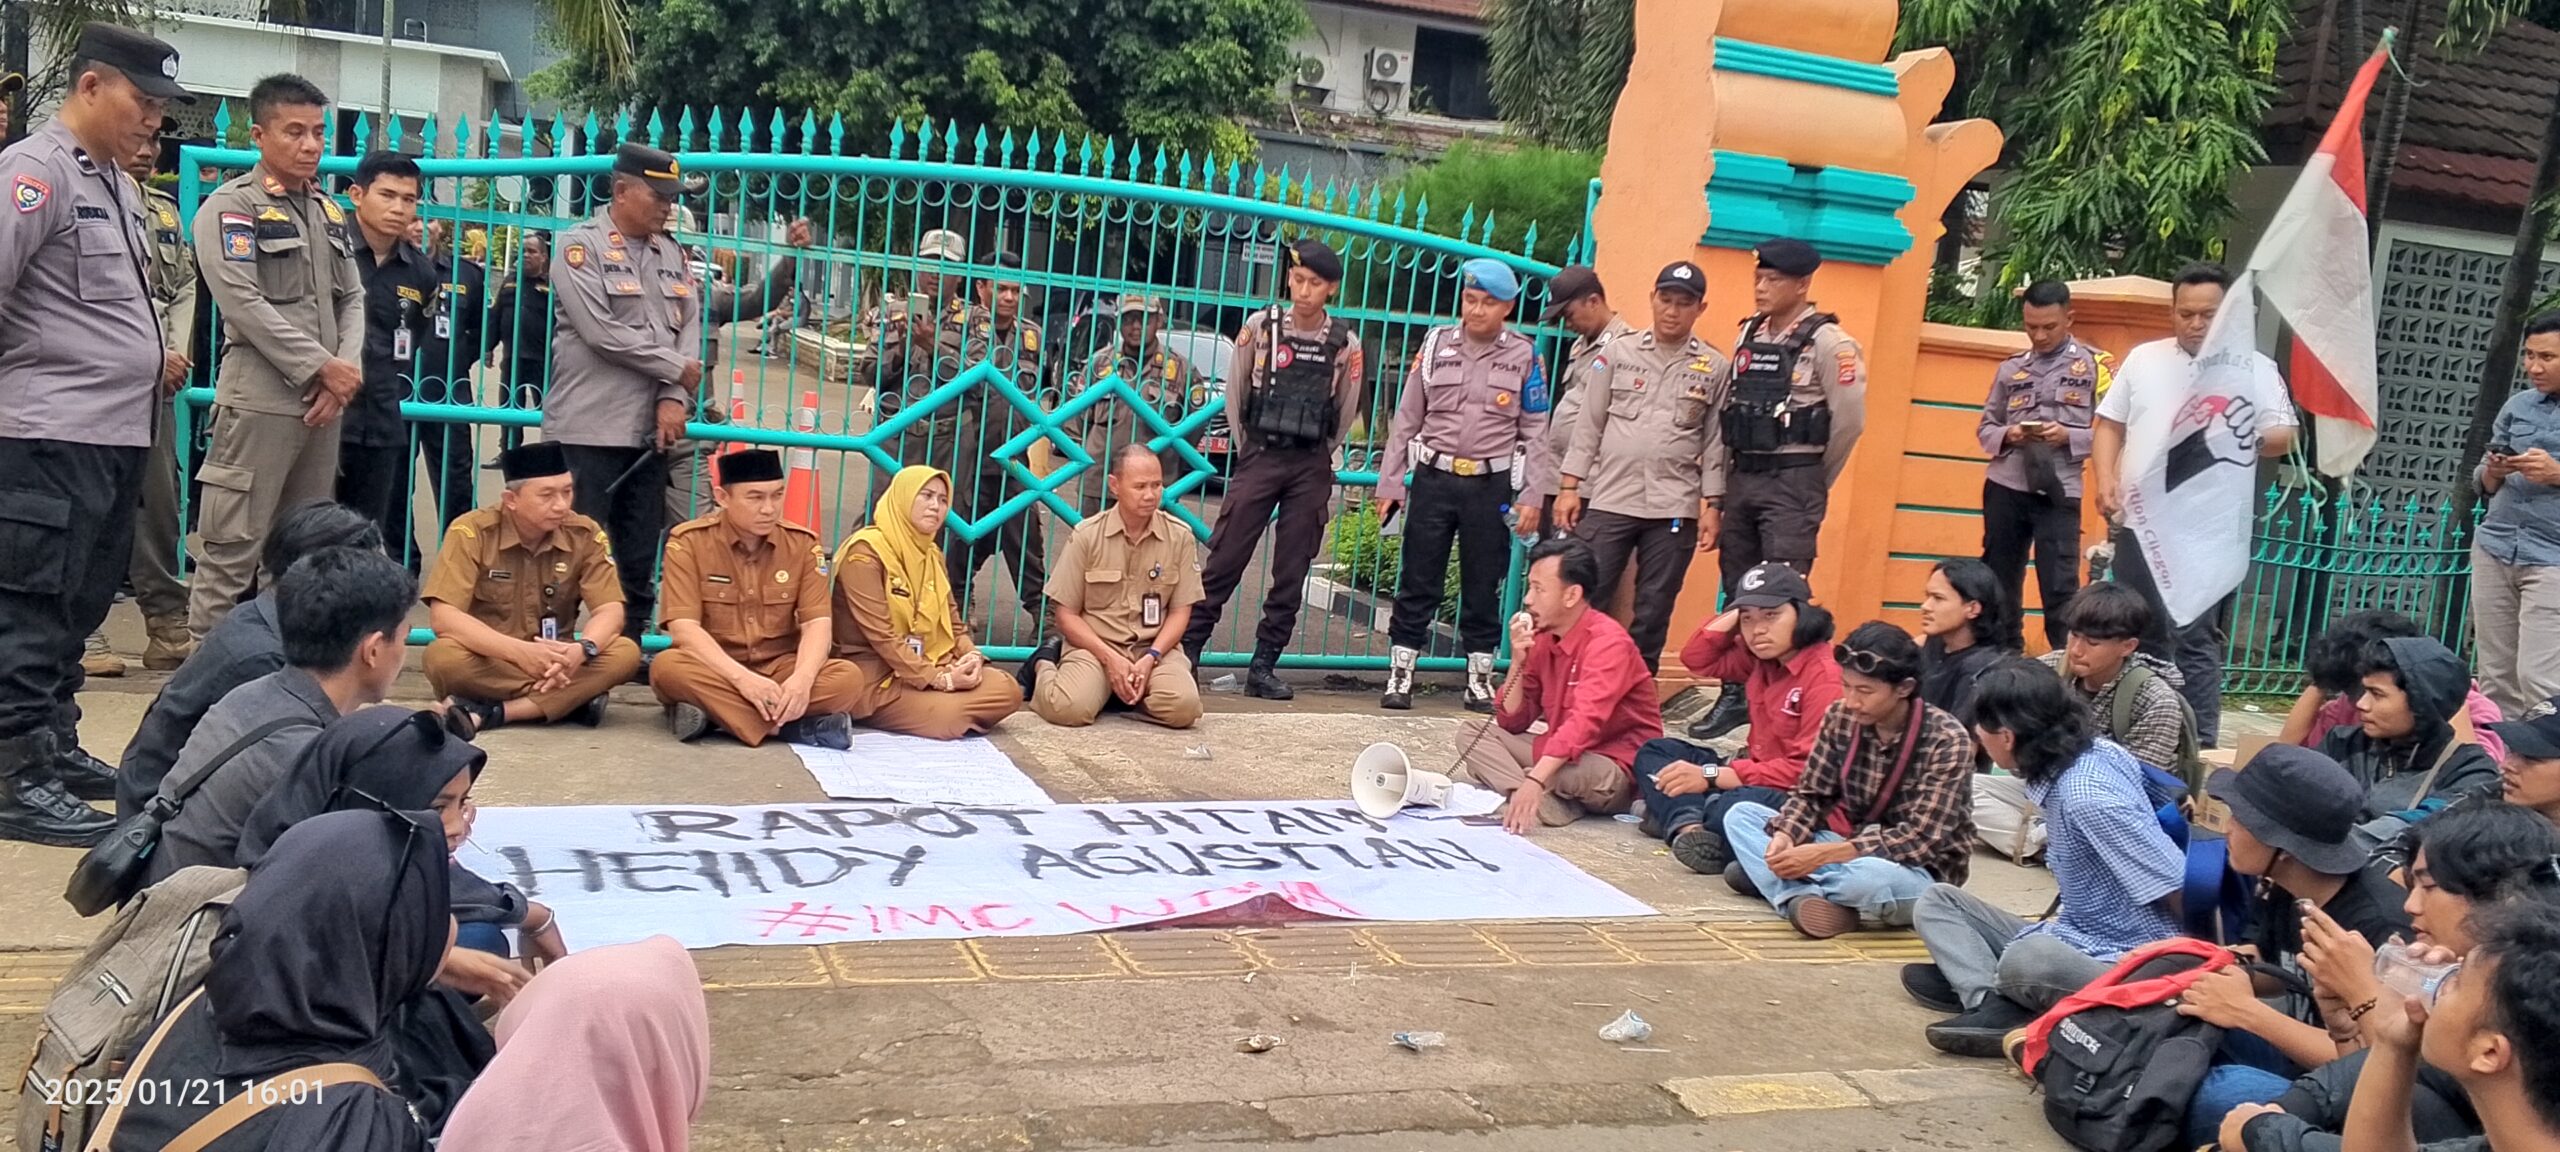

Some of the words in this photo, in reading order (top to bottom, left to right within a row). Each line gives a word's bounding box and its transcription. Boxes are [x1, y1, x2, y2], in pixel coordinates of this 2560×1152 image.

[1491, 362, 1521, 374] POLRI
[2060, 377, 2092, 388] POLRI
[641, 807, 1043, 842] RAPOT
[1084, 807, 1388, 836] HITAM
[1021, 842, 1501, 881] AGUSTIAN
[757, 902, 1034, 937] #IMC
